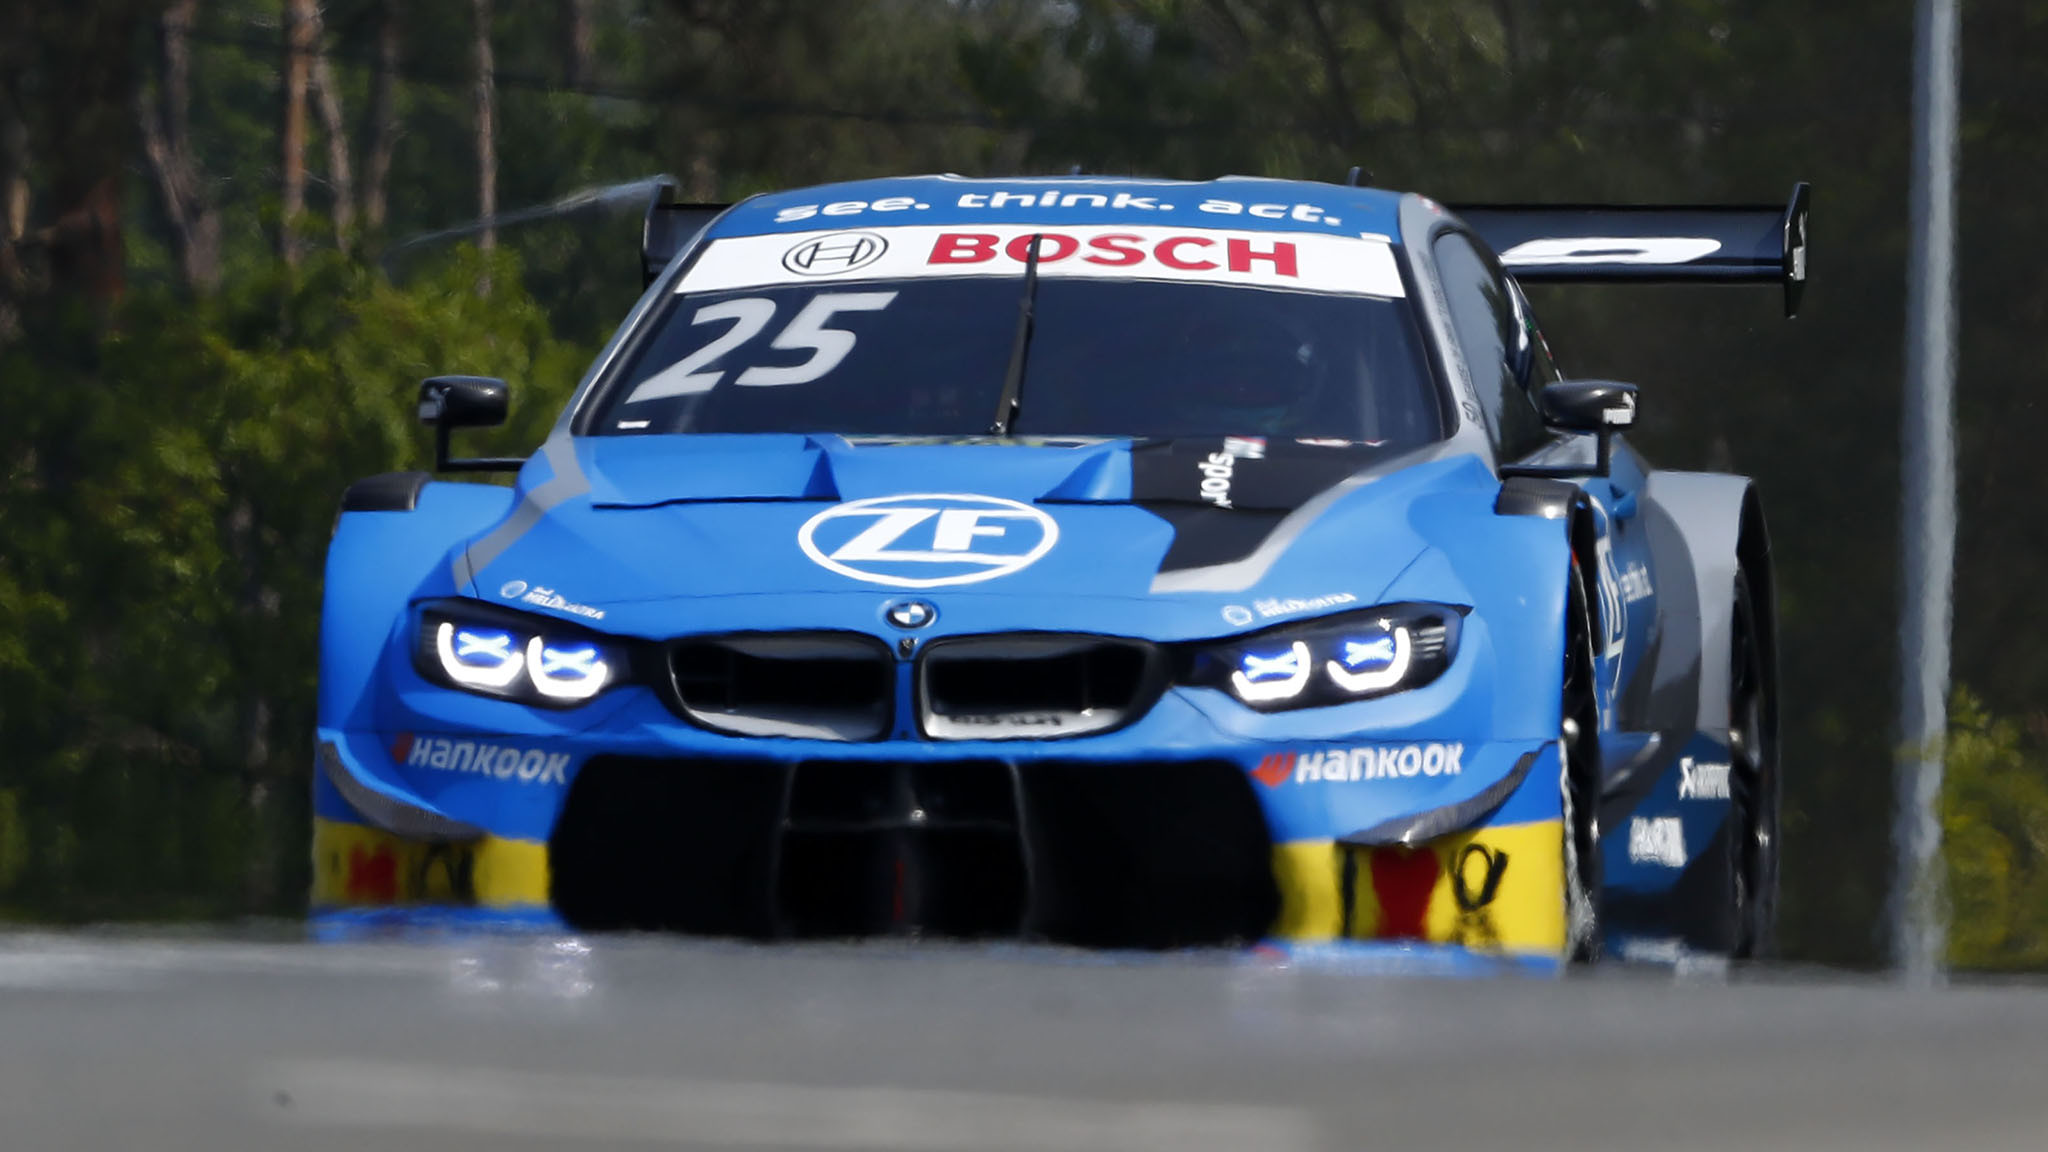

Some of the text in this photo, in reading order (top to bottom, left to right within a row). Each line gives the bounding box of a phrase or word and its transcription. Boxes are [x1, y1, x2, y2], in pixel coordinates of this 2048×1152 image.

[774, 190, 1342, 226] see. think. act.
[927, 232, 1299, 278] BOSCH
[624, 290, 899, 405] 25
[826, 505, 1038, 568] ZF
